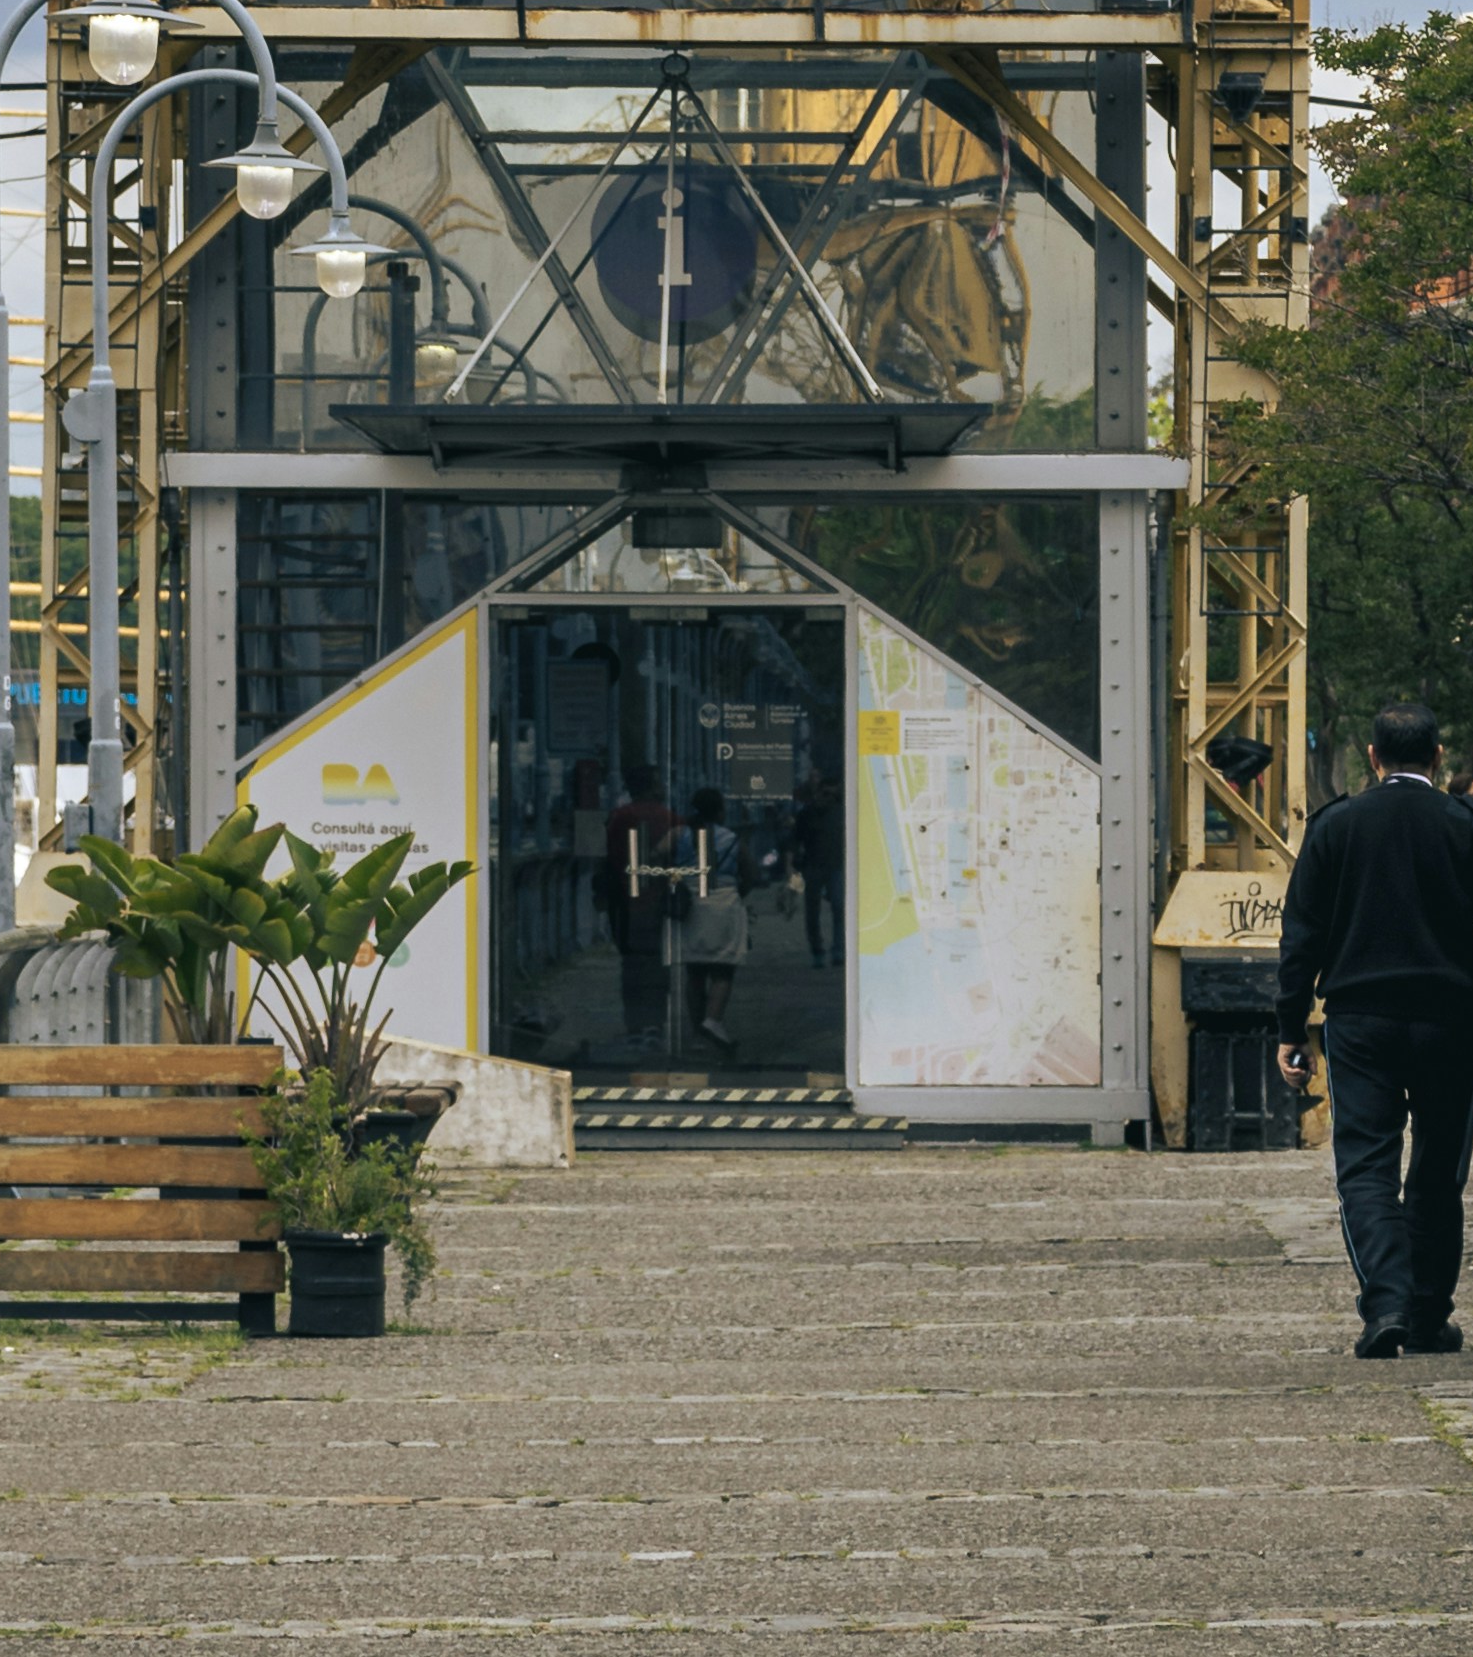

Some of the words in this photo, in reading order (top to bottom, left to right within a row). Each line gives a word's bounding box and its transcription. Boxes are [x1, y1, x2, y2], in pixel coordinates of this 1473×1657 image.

[321, 763, 399, 805] BA
[311, 821, 375, 835] Consultá
[320, 840, 367, 853] visitas
